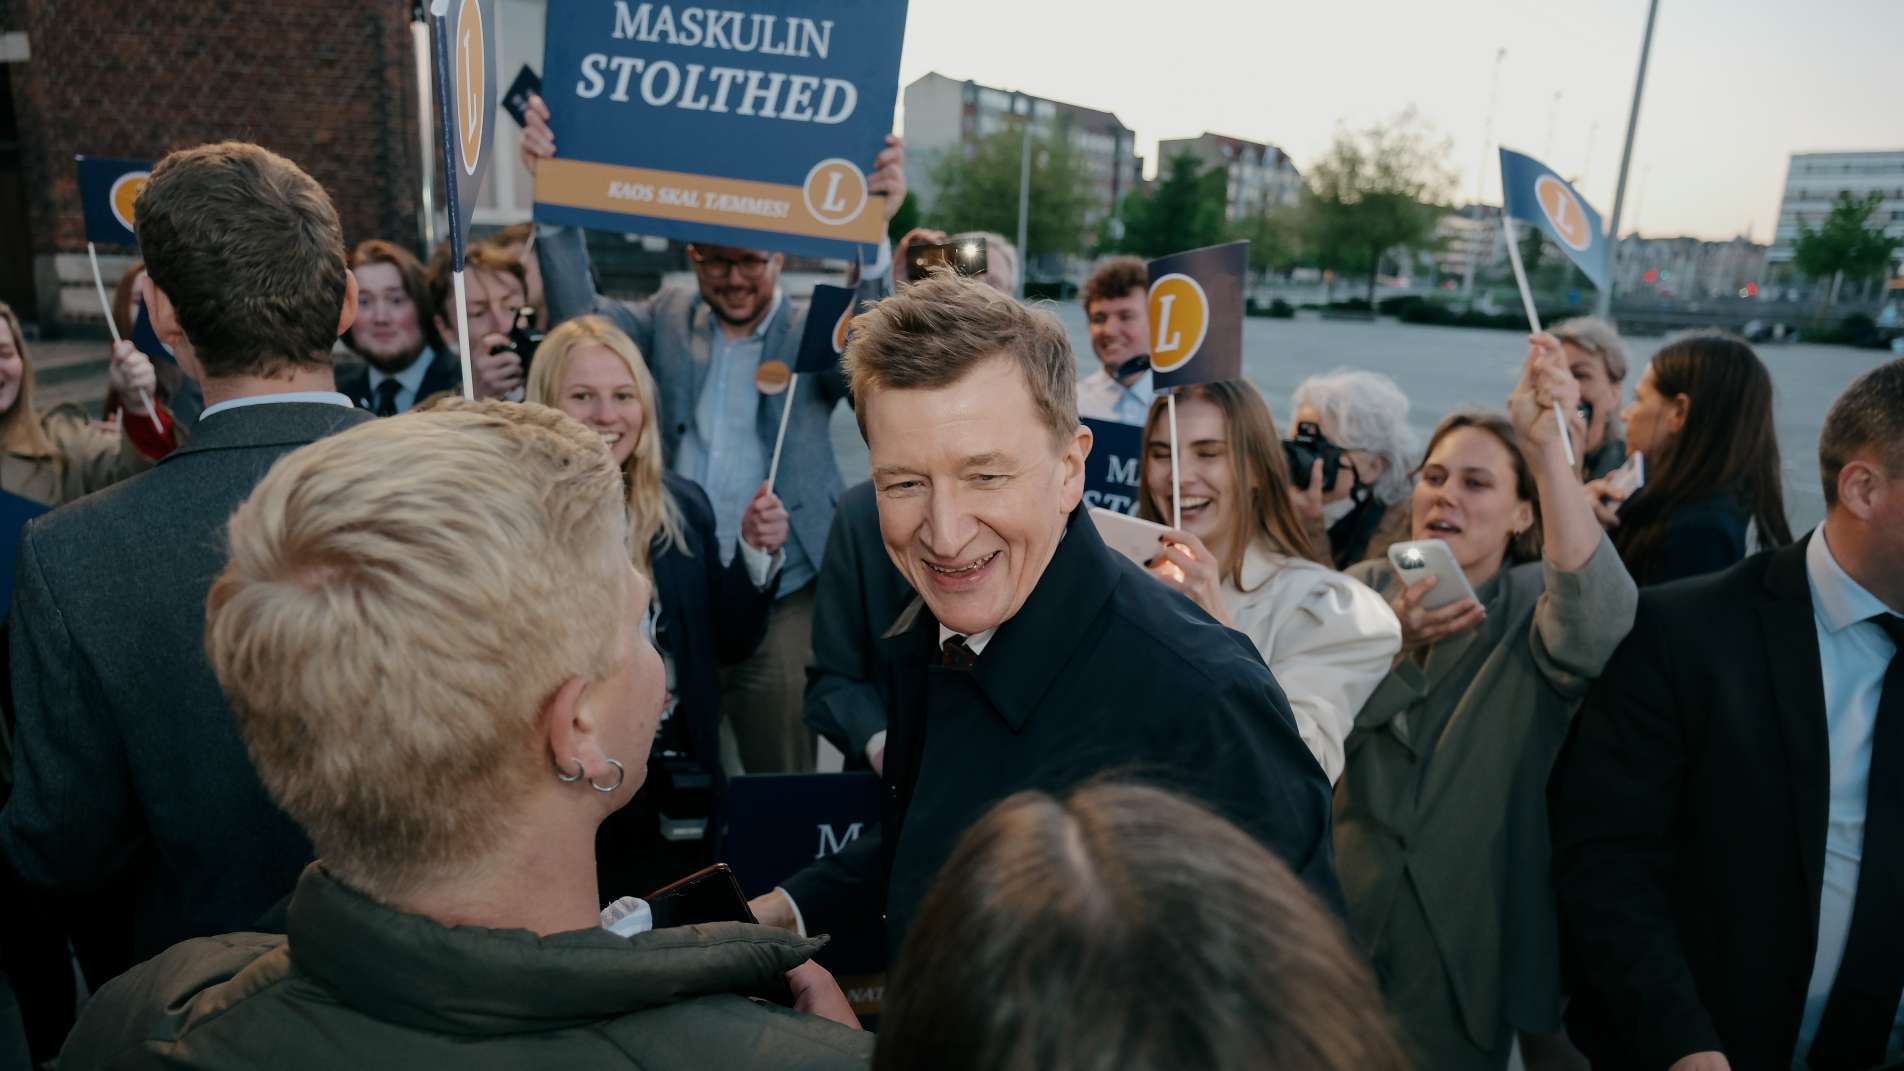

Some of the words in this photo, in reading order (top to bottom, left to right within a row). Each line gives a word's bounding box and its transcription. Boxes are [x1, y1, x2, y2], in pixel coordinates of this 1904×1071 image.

[613, 2, 834, 59] MASKULIN
[575, 53, 858, 125] STOLTHED
[608, 181, 654, 201] KAOS
[657, 187, 700, 208] SKAL
[704, 192, 790, 218] TÆMMES!
[821, 172, 845, 212] L
[1155, 294, 1180, 353] L
[1106, 454, 1141, 487] M
